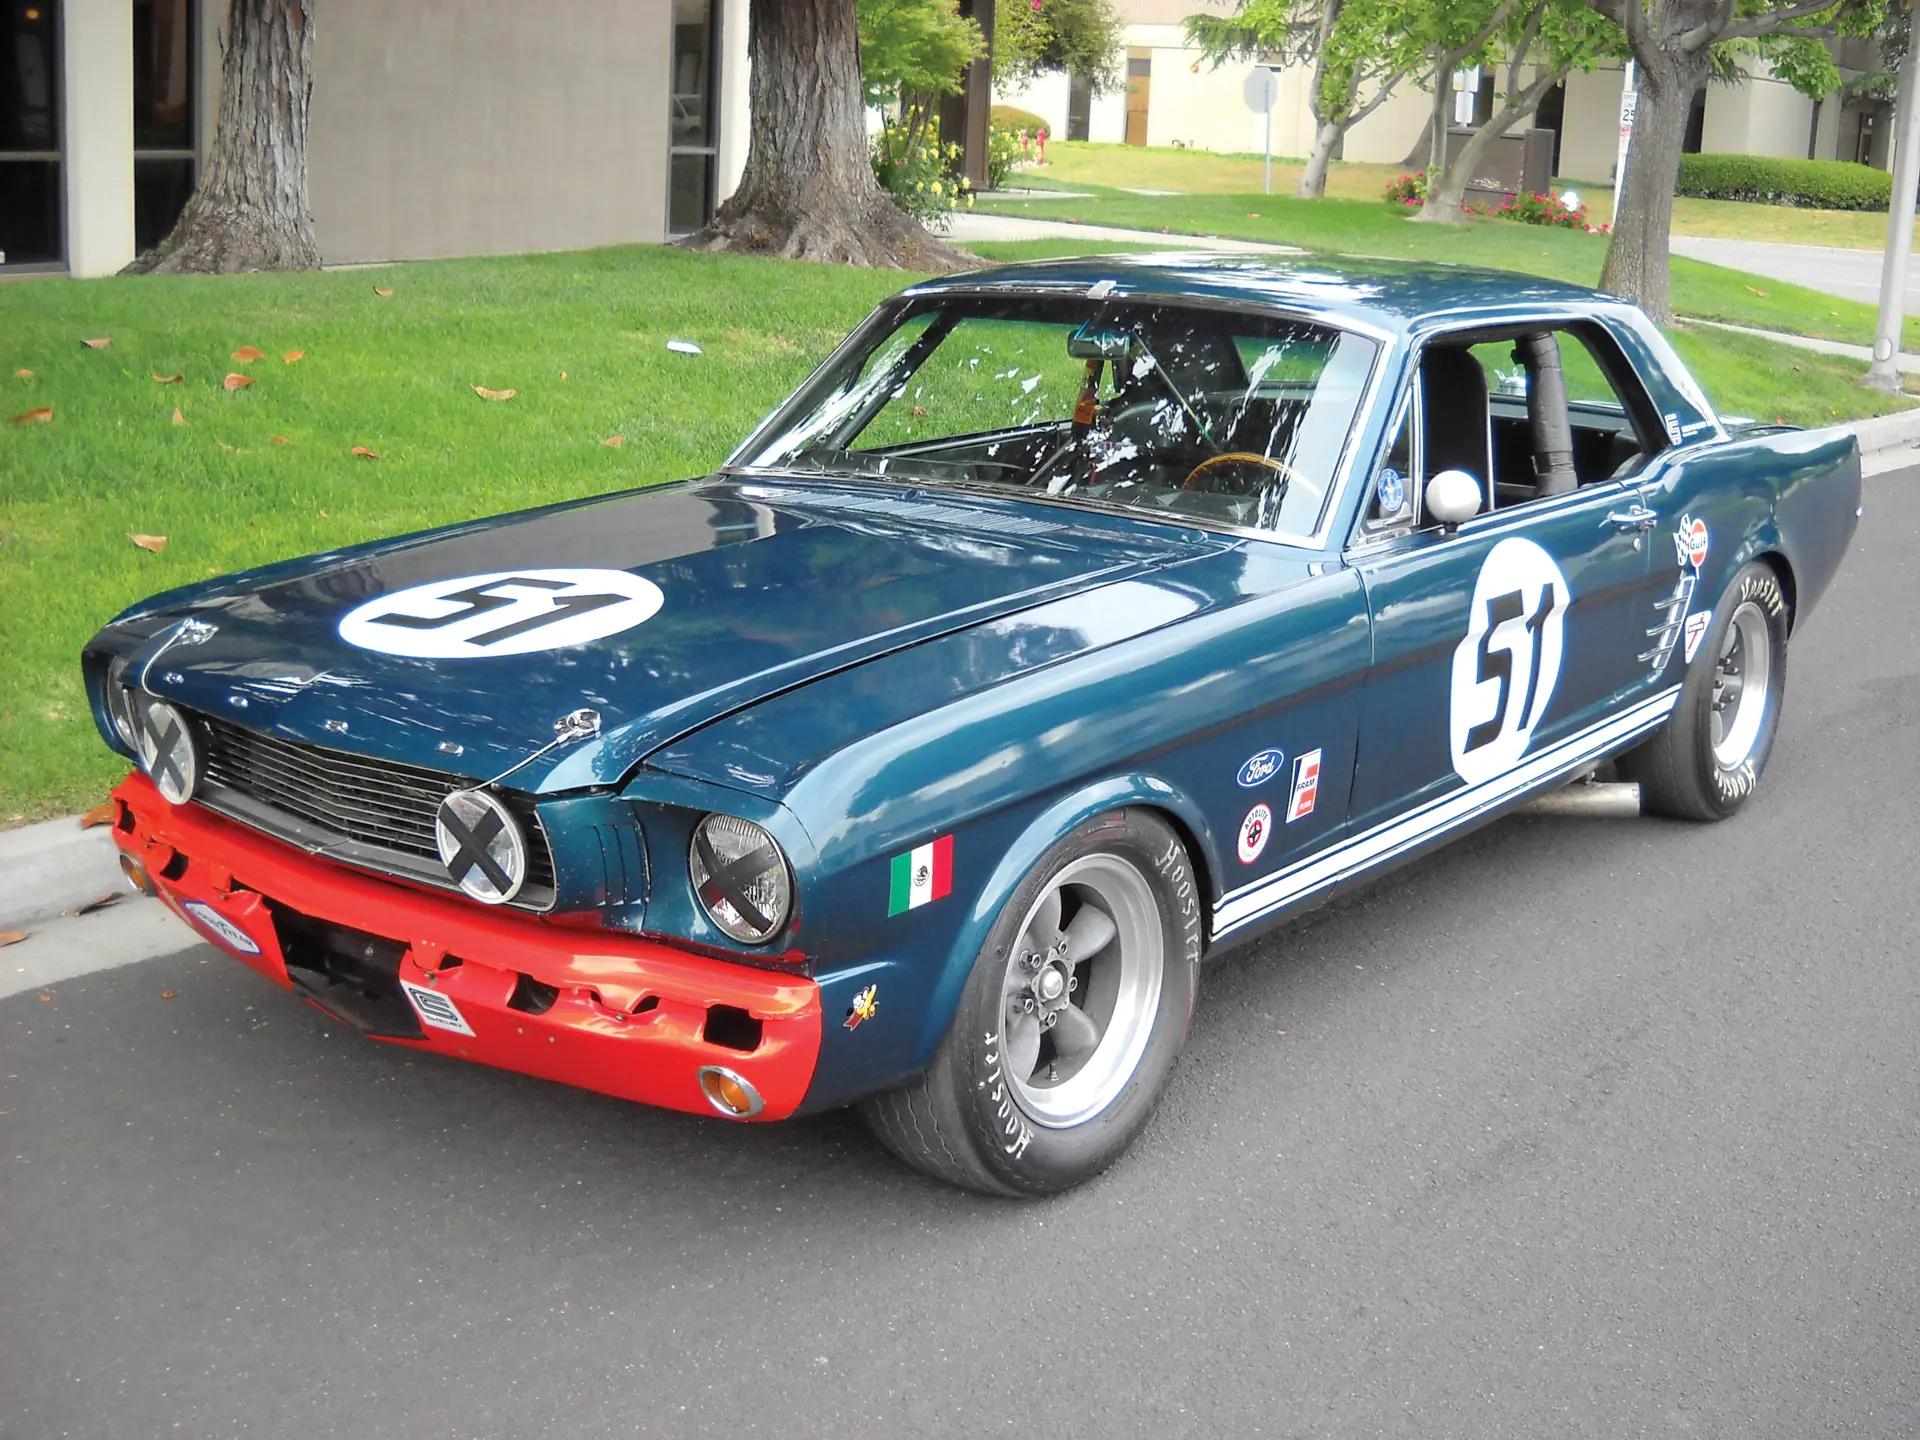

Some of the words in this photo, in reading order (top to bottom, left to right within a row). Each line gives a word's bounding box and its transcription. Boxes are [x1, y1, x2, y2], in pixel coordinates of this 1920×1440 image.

[1690, 537, 1706, 550] Gulf
[365, 577, 633, 647] 51
[1463, 583, 1555, 755] 51
[1246, 754, 1276, 782] Ford
[1297, 778, 1315, 791] FRAM
[1244, 808, 1268, 831] AUTOLITE
